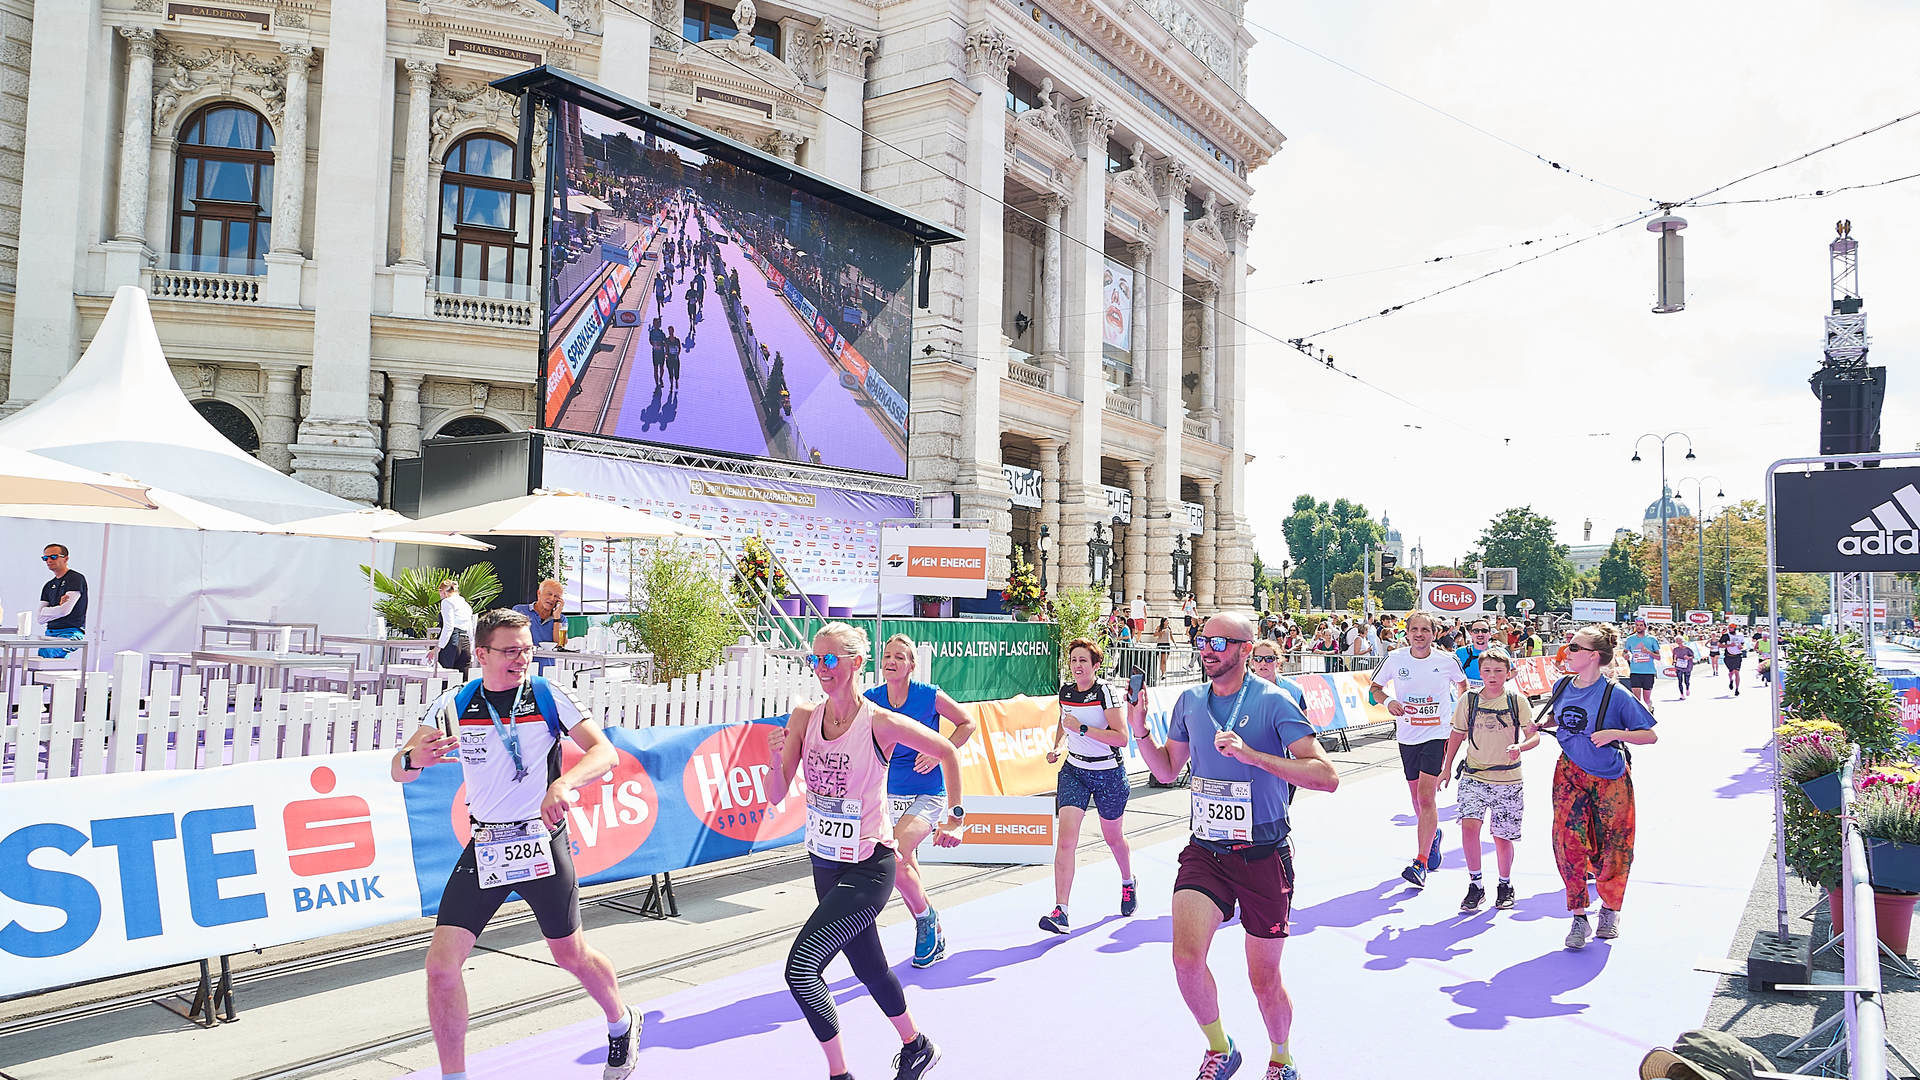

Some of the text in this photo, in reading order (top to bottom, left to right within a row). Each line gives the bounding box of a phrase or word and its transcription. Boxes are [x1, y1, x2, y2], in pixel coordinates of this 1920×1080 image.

[192, 7, 247, 20] CALDERON
[463, 43, 528, 60] SHAKESPEARE
[567, 314, 601, 369] SPARKASSE
[866, 375, 907, 426] SPARKASSE
[721, 486, 747, 497] VIENNA
[763, 490, 798, 503] MARATHON
[798, 497, 813, 505] 2021
[911, 556, 981, 569] WIEN ENERGIE
[1433, 589, 1473, 606] Hervis
[940, 641, 966, 658] AUS
[965, 641, 997, 658] ALTEN
[999, 640, 1050, 656] FLASCHEN.
[1408, 696, 1426, 704] ERSTE
[1418, 705, 1439, 715] 4687
[960, 724, 1058, 768] EN ENERG
[807, 749, 850, 770] ENER
[807, 768, 847, 786] GIZE
[717, 808, 775, 830] SPORTS
[1208, 803, 1245, 821] 528D
[818, 819, 854, 839] 527D
[994, 824, 1048, 835] ENERGIE
[504, 841, 545, 861] 528A
[293, 875, 384, 913] BANK
